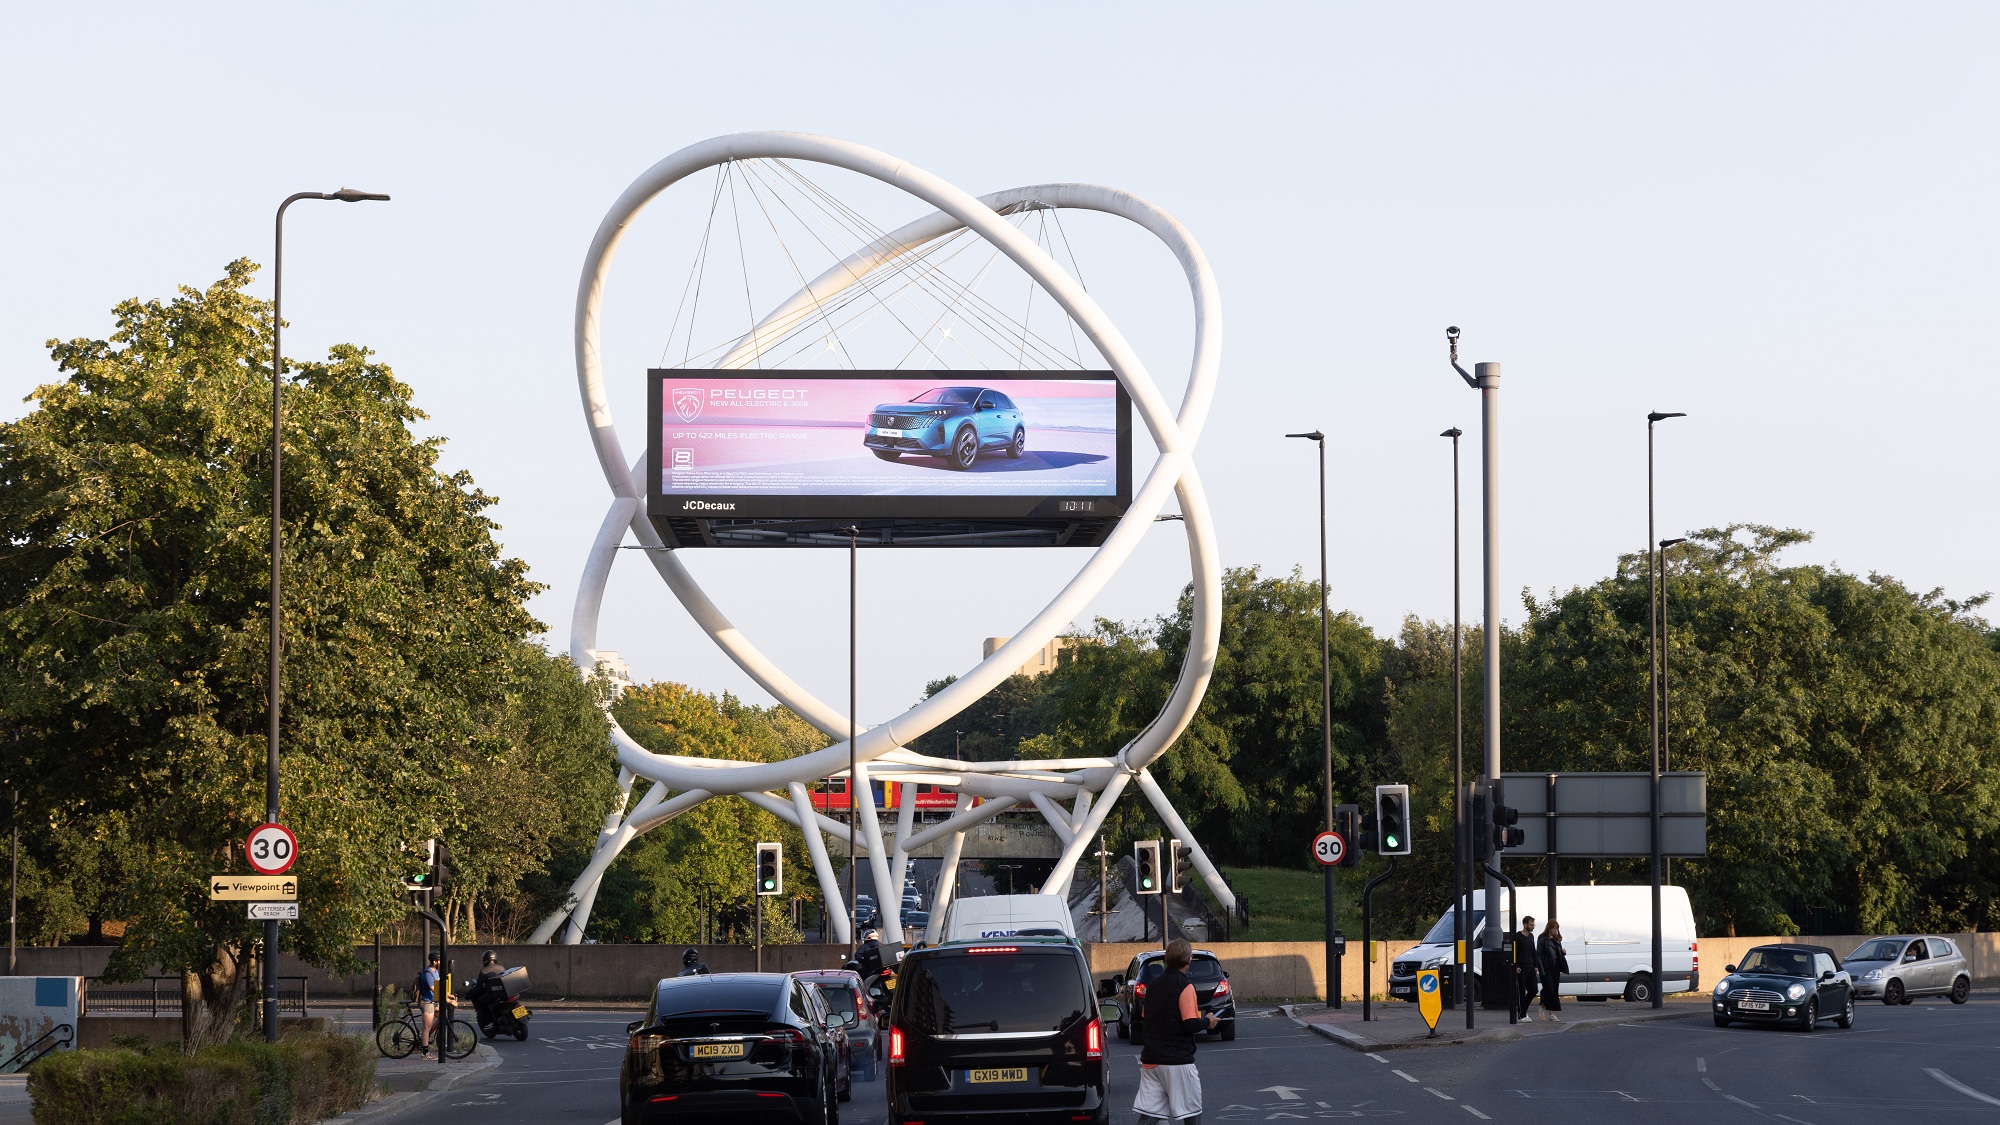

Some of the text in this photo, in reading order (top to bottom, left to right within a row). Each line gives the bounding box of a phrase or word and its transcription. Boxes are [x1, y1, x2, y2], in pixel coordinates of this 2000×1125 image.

[710, 389, 809, 399] PEUGEOT
[739, 432, 778, 440] ELECTRIC
[780, 432, 808, 440] RANGE
[682, 500, 736, 510] JCDecaux
[1065, 501, 1092, 511] 10:11
[253, 838, 290, 859] 30
[1317, 841, 1341, 855] 30
[232, 883, 280, 893] Viewpoint
[697, 1045, 740, 1055] MC19 ZXD
[974, 1069, 1023, 1081] GX19 MWD
